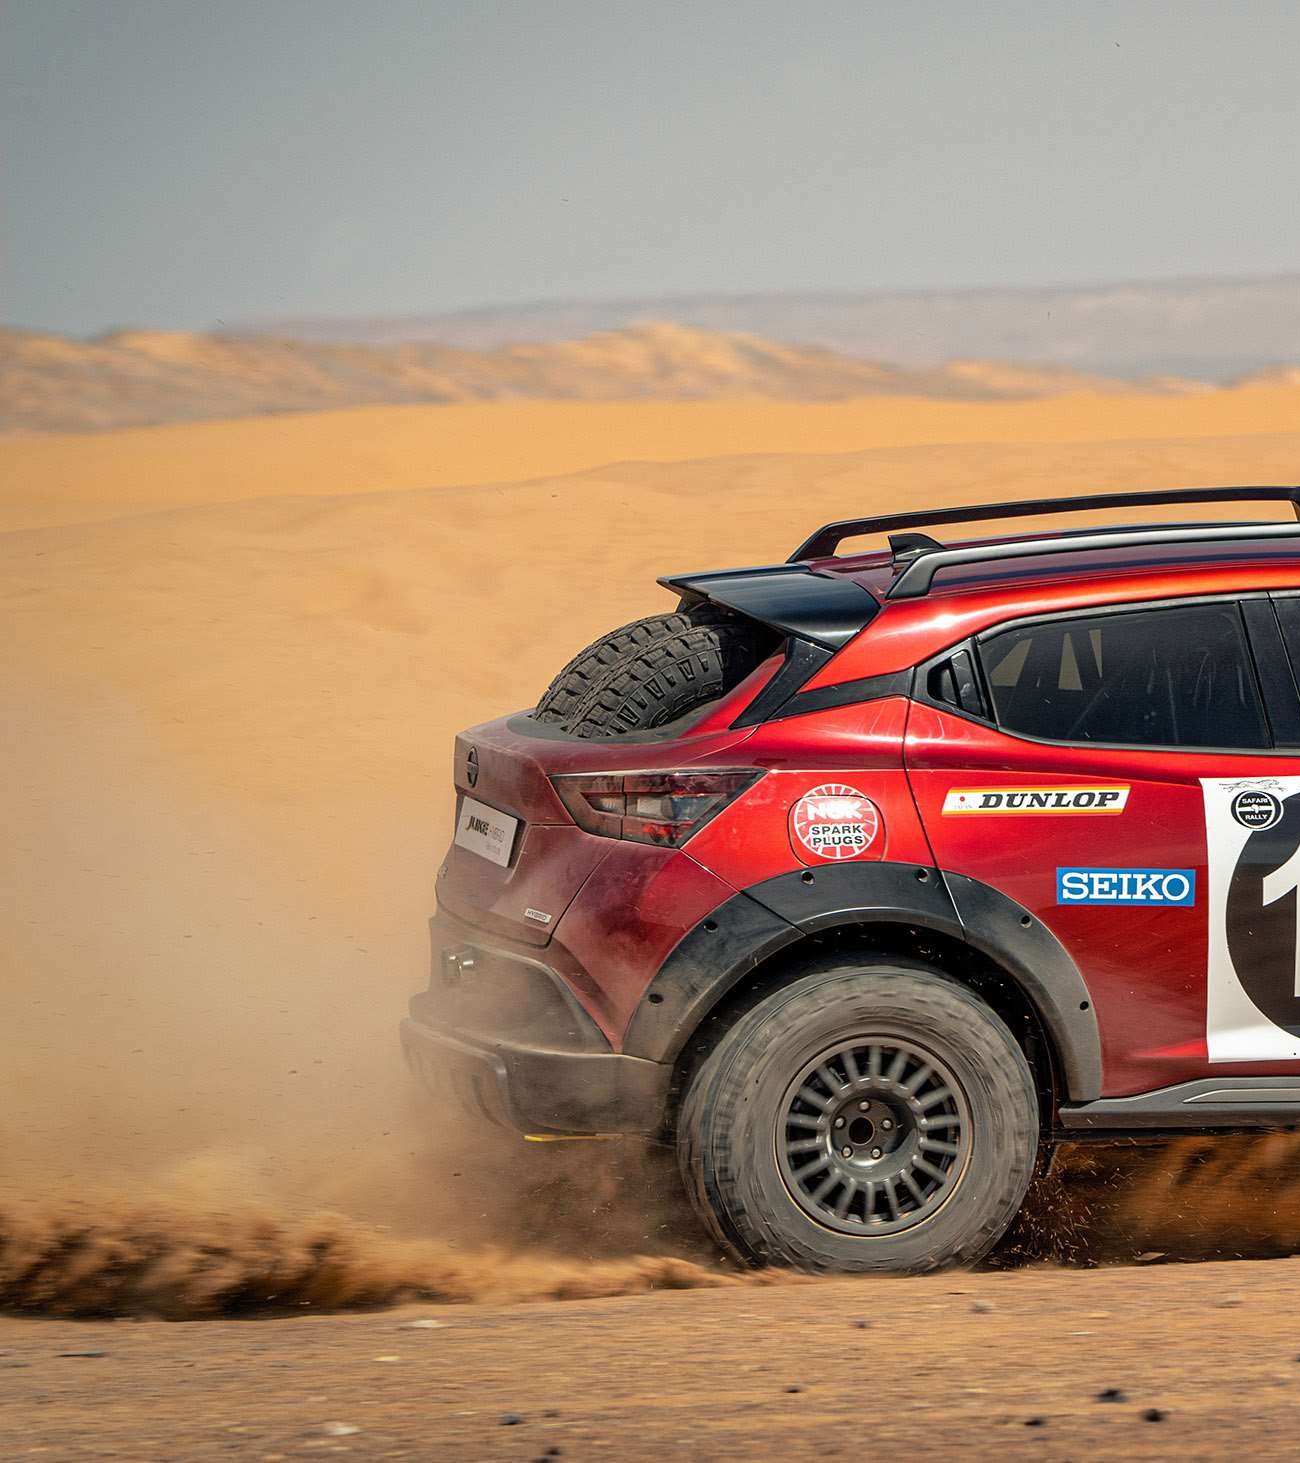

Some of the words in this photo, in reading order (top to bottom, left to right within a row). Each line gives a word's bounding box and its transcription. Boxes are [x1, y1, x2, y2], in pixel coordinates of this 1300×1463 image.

[979, 792, 1119, 808] DUNLOP
[811, 825, 862, 835] SPARK
[813, 836, 863, 846] PLUGS
[1062, 872, 1190, 901] SEIKO
